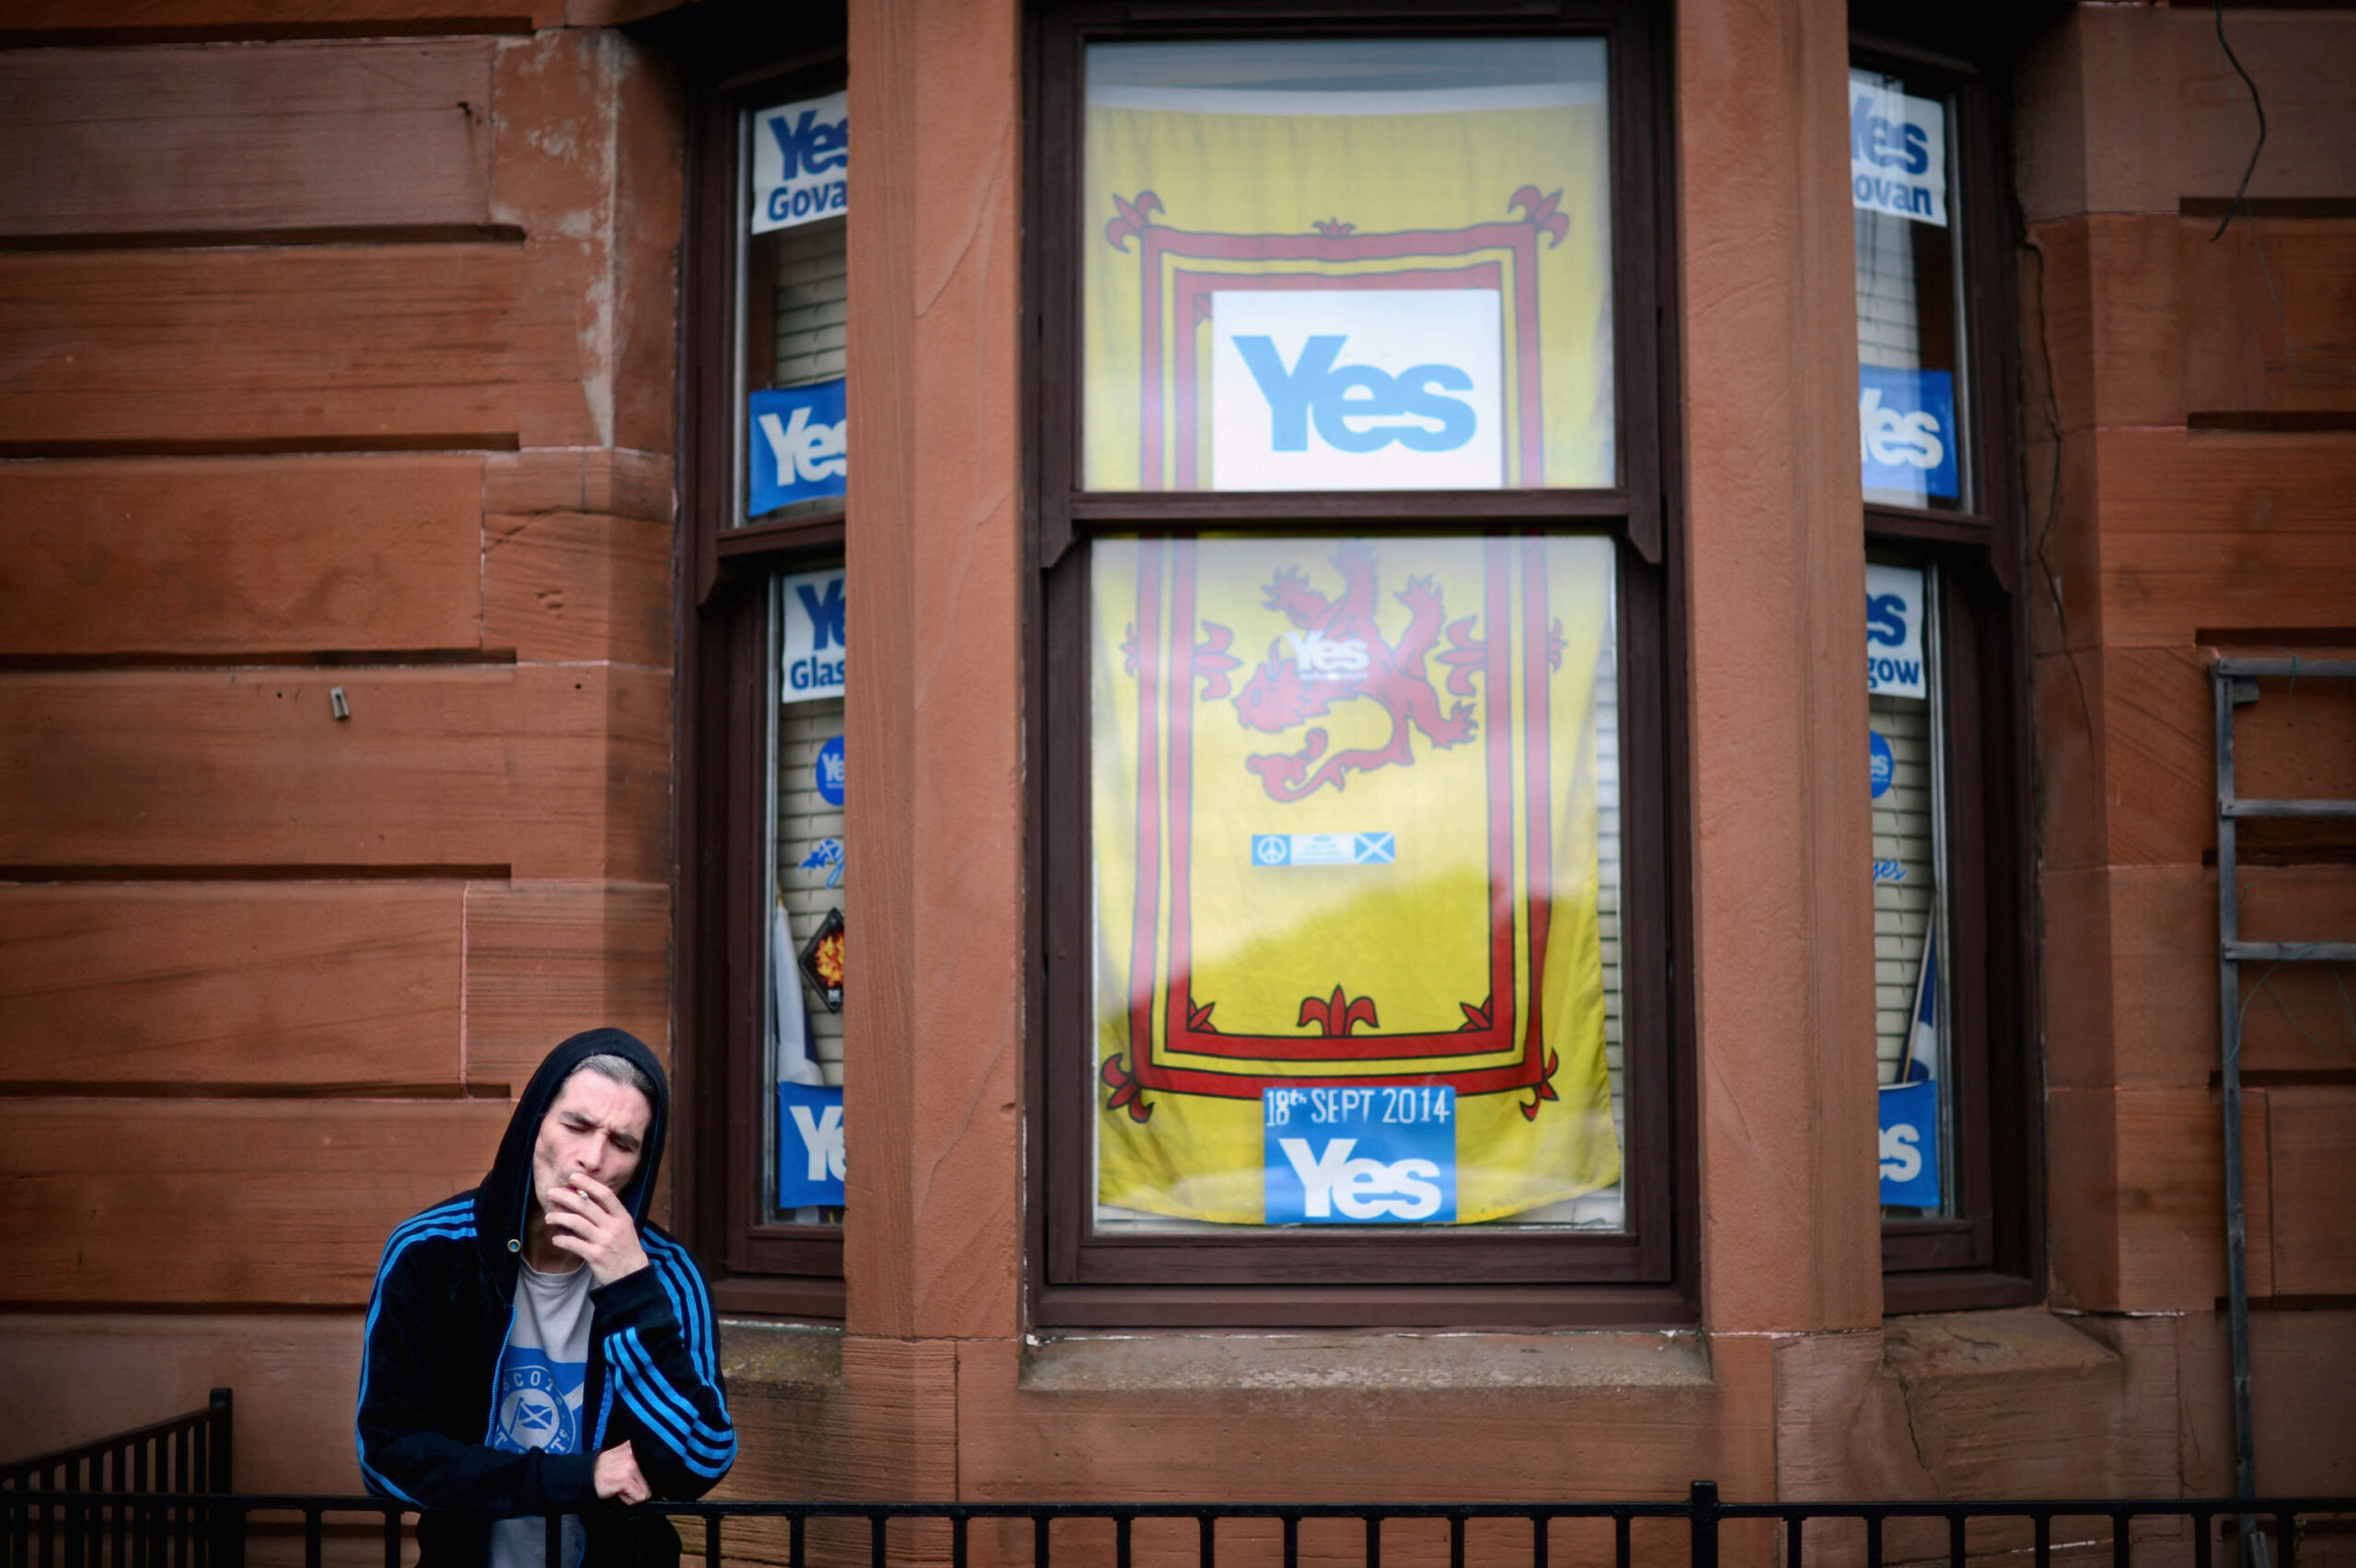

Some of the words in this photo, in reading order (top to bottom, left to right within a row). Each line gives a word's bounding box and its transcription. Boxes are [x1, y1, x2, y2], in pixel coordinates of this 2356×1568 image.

[768, 180, 847, 222] Gova
[1854, 174, 1933, 216] ovan
[1231, 335, 1477, 454] Yes
[1287, 631, 1369, 671] Yes
[791, 655, 845, 690] Glas
[822, 753, 844, 781] Ye
[1311, 1089, 1375, 1124] SEPT
[1381, 1088, 1450, 1124] 2014
[1278, 1138, 1442, 1219] Yes
